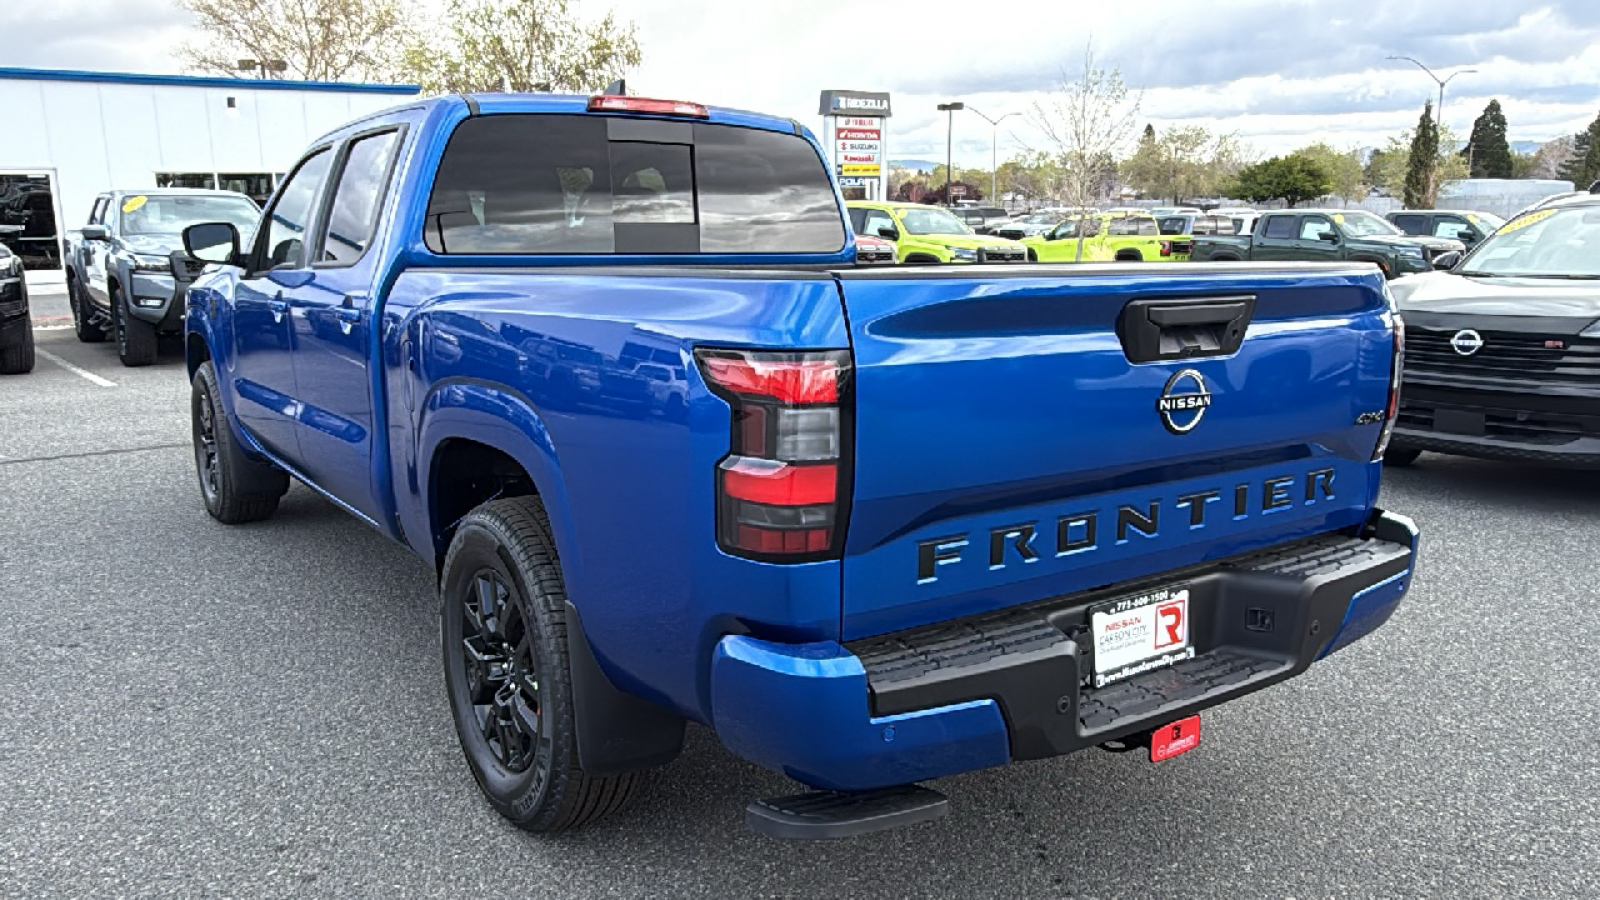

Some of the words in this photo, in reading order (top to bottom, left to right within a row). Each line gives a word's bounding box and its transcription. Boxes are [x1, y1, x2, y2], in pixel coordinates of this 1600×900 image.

[849, 143, 878, 151] SUZUKI
[1160, 395, 1210, 410] NISSAN
[916, 467, 1336, 585] FRONTIER
[1105, 616, 1142, 632] NISSAN
